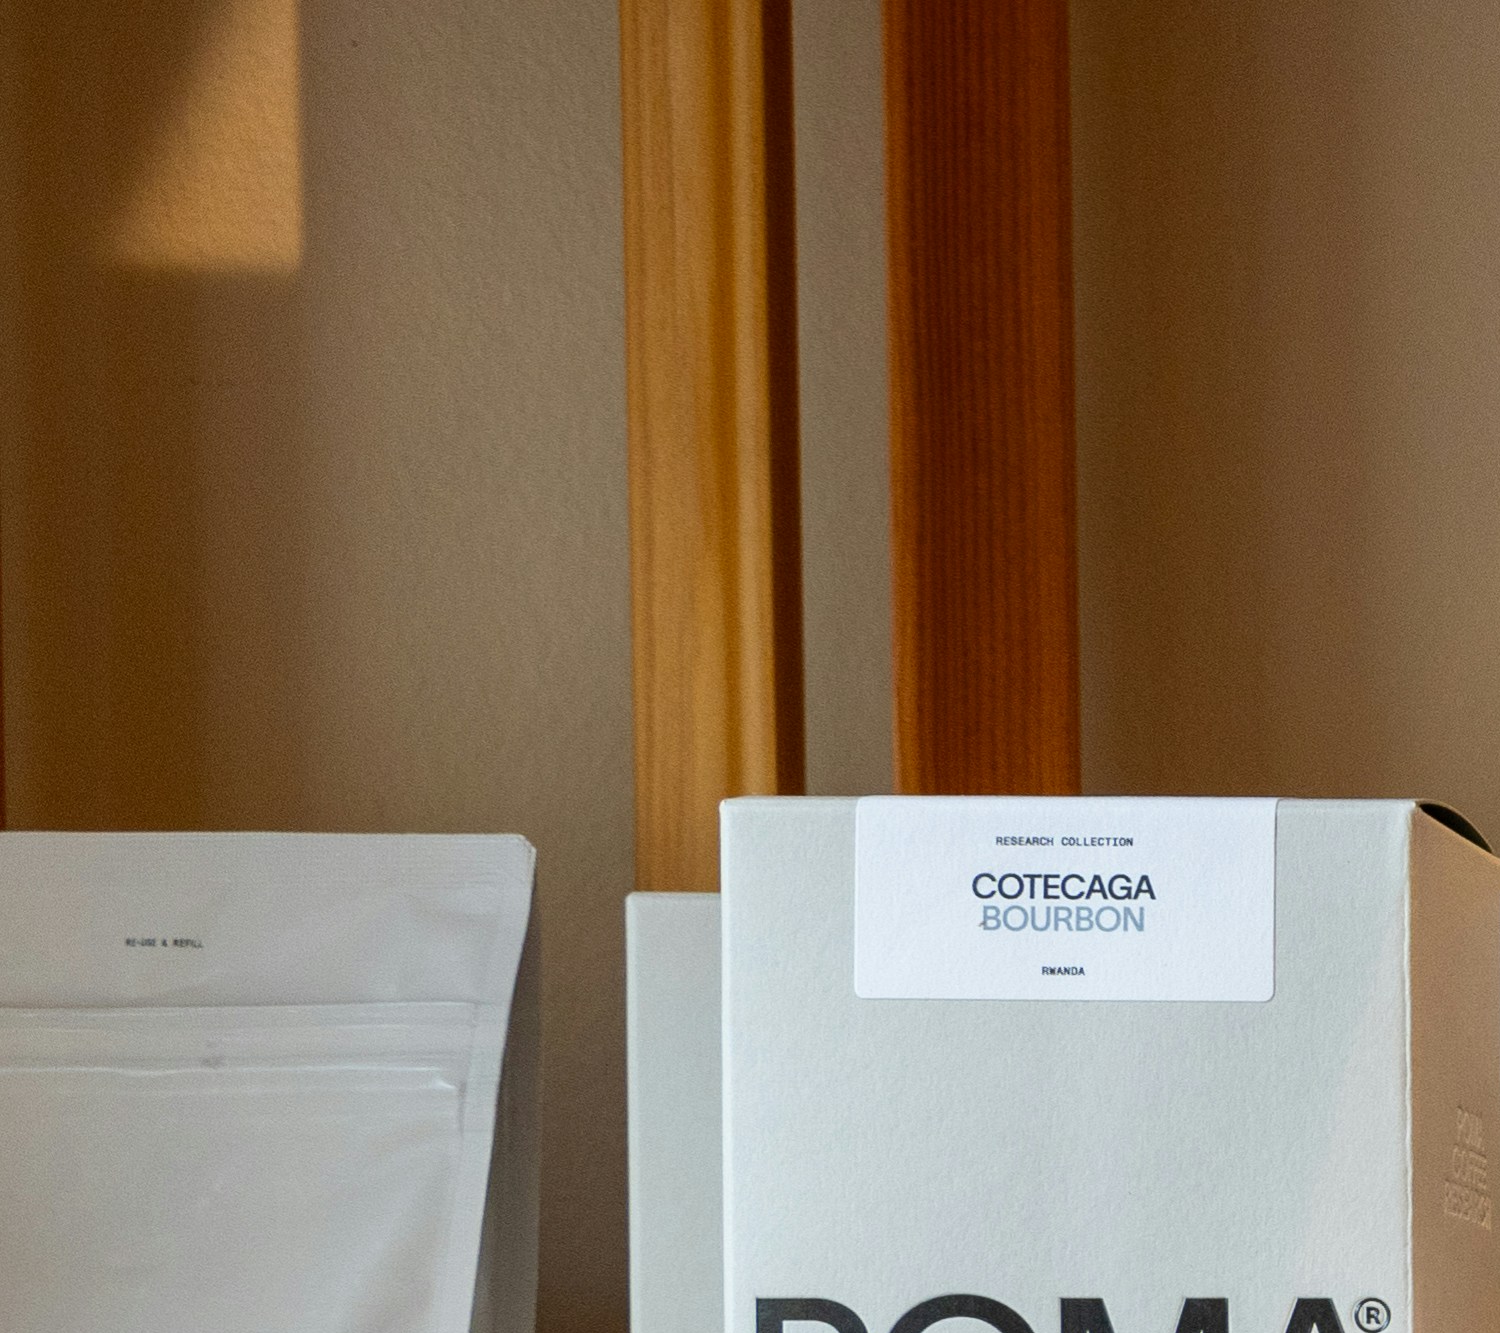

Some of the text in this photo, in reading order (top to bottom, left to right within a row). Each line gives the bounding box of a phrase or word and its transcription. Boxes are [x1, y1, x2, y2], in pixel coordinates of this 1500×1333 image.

[995, 835, 1134, 847] RESEARCH COLLECTION
[971, 872, 1156, 901] COTECAGA
[981, 904, 1145, 933] BOURBON
[1041, 966, 1085, 976] RWANDA
